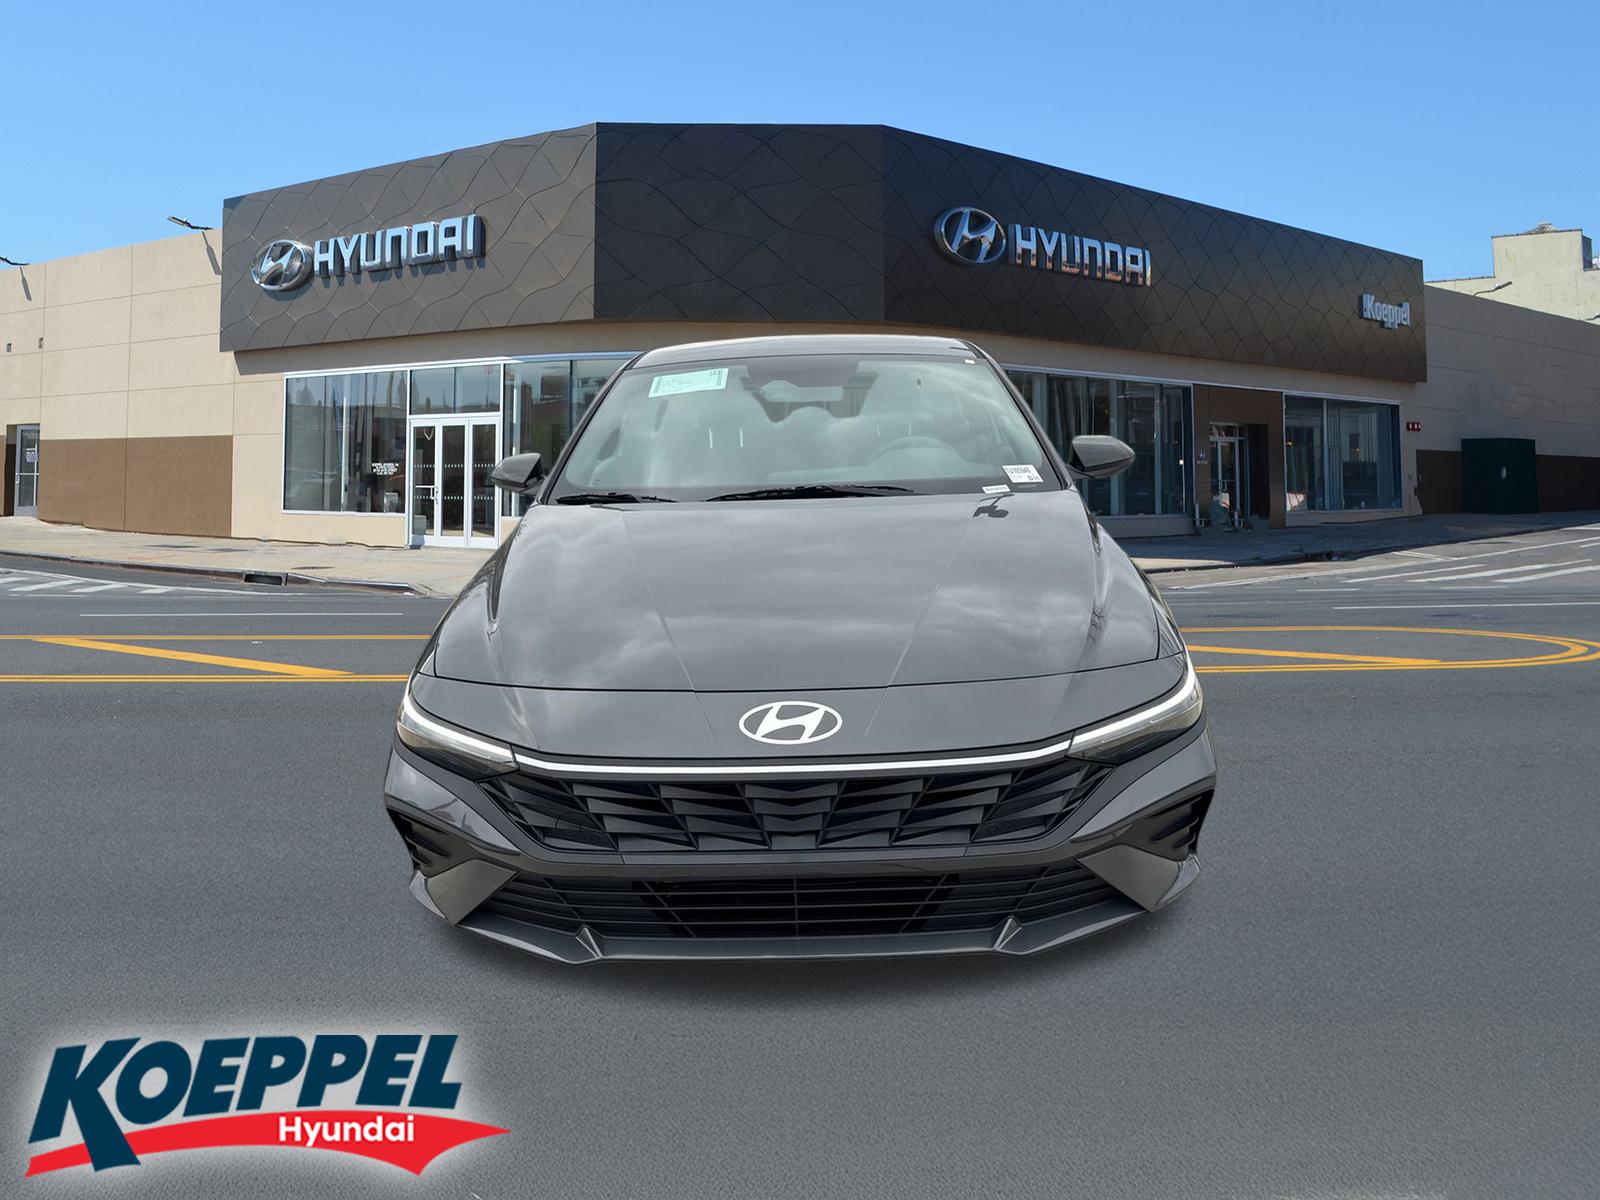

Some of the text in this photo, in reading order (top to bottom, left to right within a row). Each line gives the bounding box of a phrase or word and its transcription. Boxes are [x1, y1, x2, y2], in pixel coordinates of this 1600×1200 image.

[314, 214, 483, 277] HYUNDAI
[1011, 223, 1151, 287] HYUNDAI
[1362, 294, 1410, 329] Koeppel
